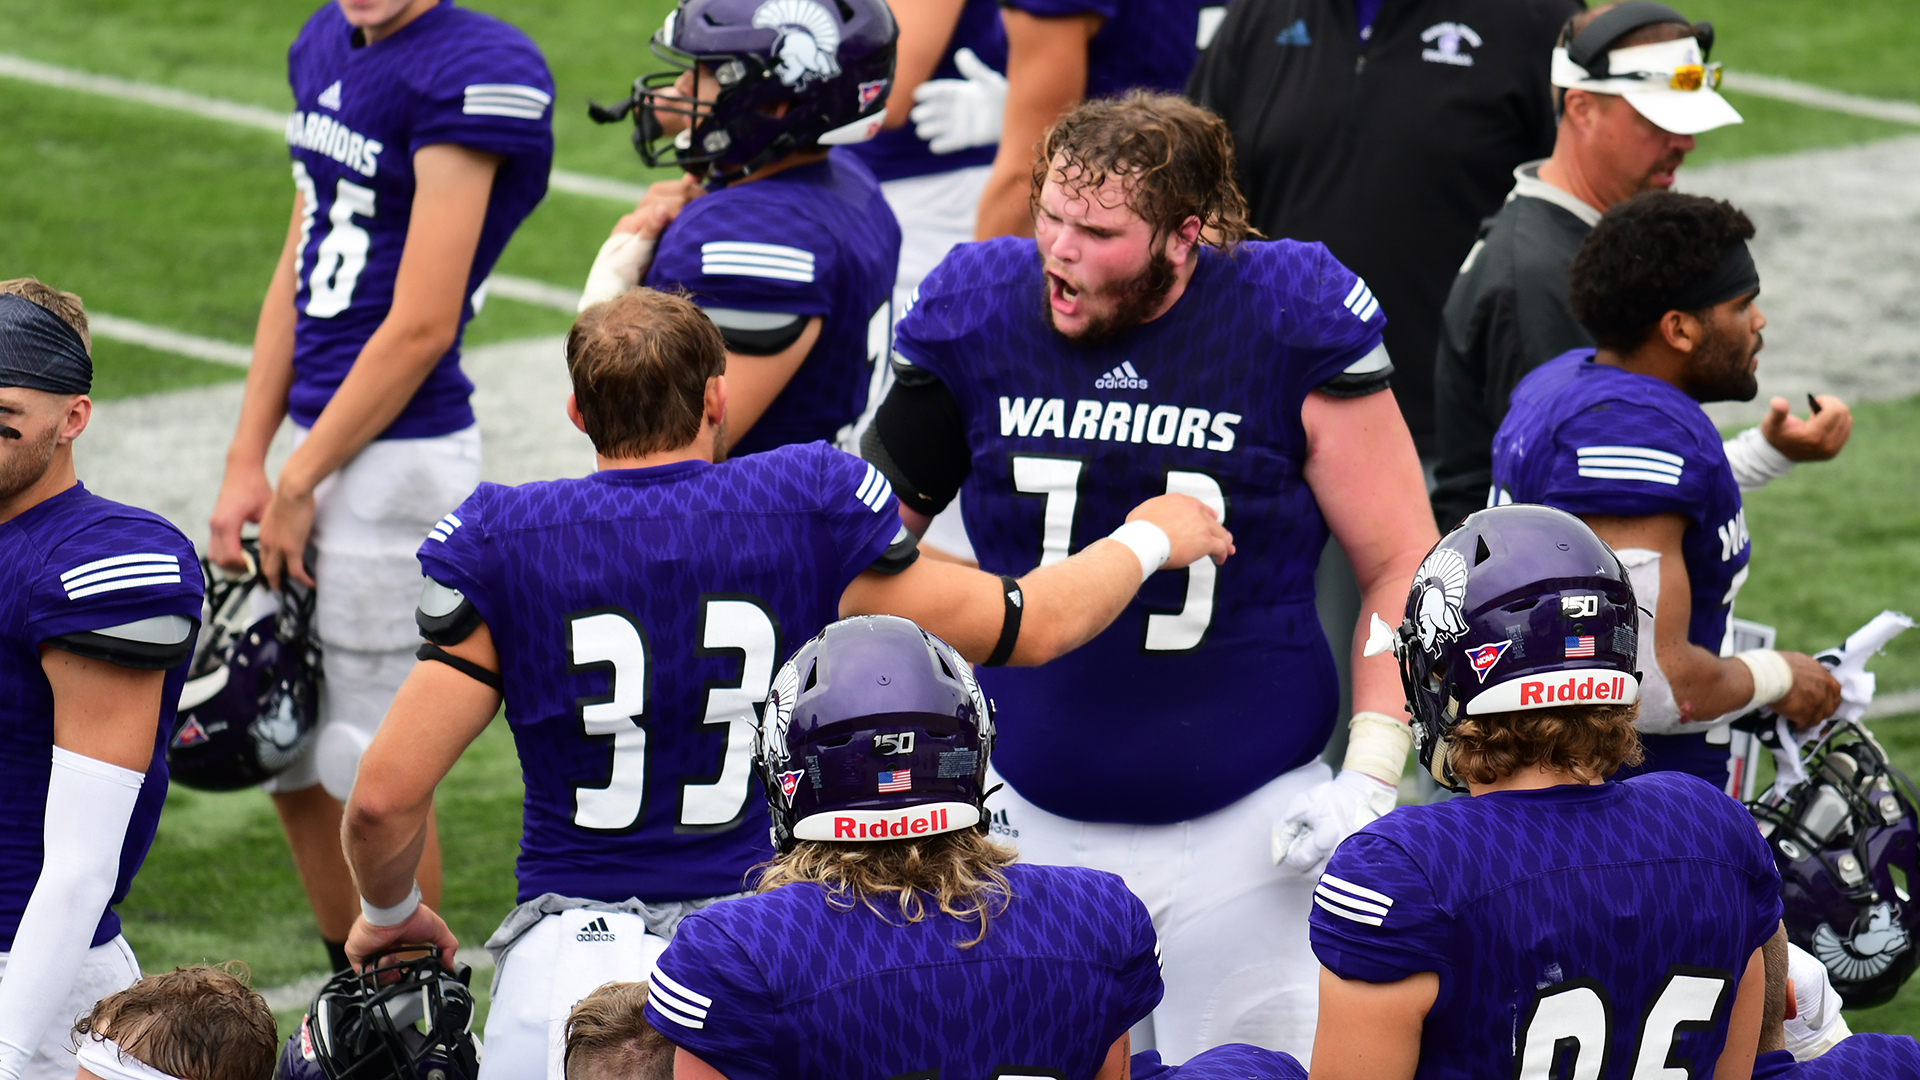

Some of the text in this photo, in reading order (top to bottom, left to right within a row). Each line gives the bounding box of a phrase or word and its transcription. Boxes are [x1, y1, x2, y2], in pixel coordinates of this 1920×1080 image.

[1095, 376, 1148, 390] adidas
[999, 396, 1242, 452] WARRIORS
[1560, 595, 1598, 618] 150
[1476, 653, 1495, 666] NCAA
[1520, 677, 1625, 706] Riddell
[571, 600, 776, 829] 33
[873, 731, 916, 756] 150
[834, 808, 948, 838] Riddell
[576, 931, 616, 942] adidas
